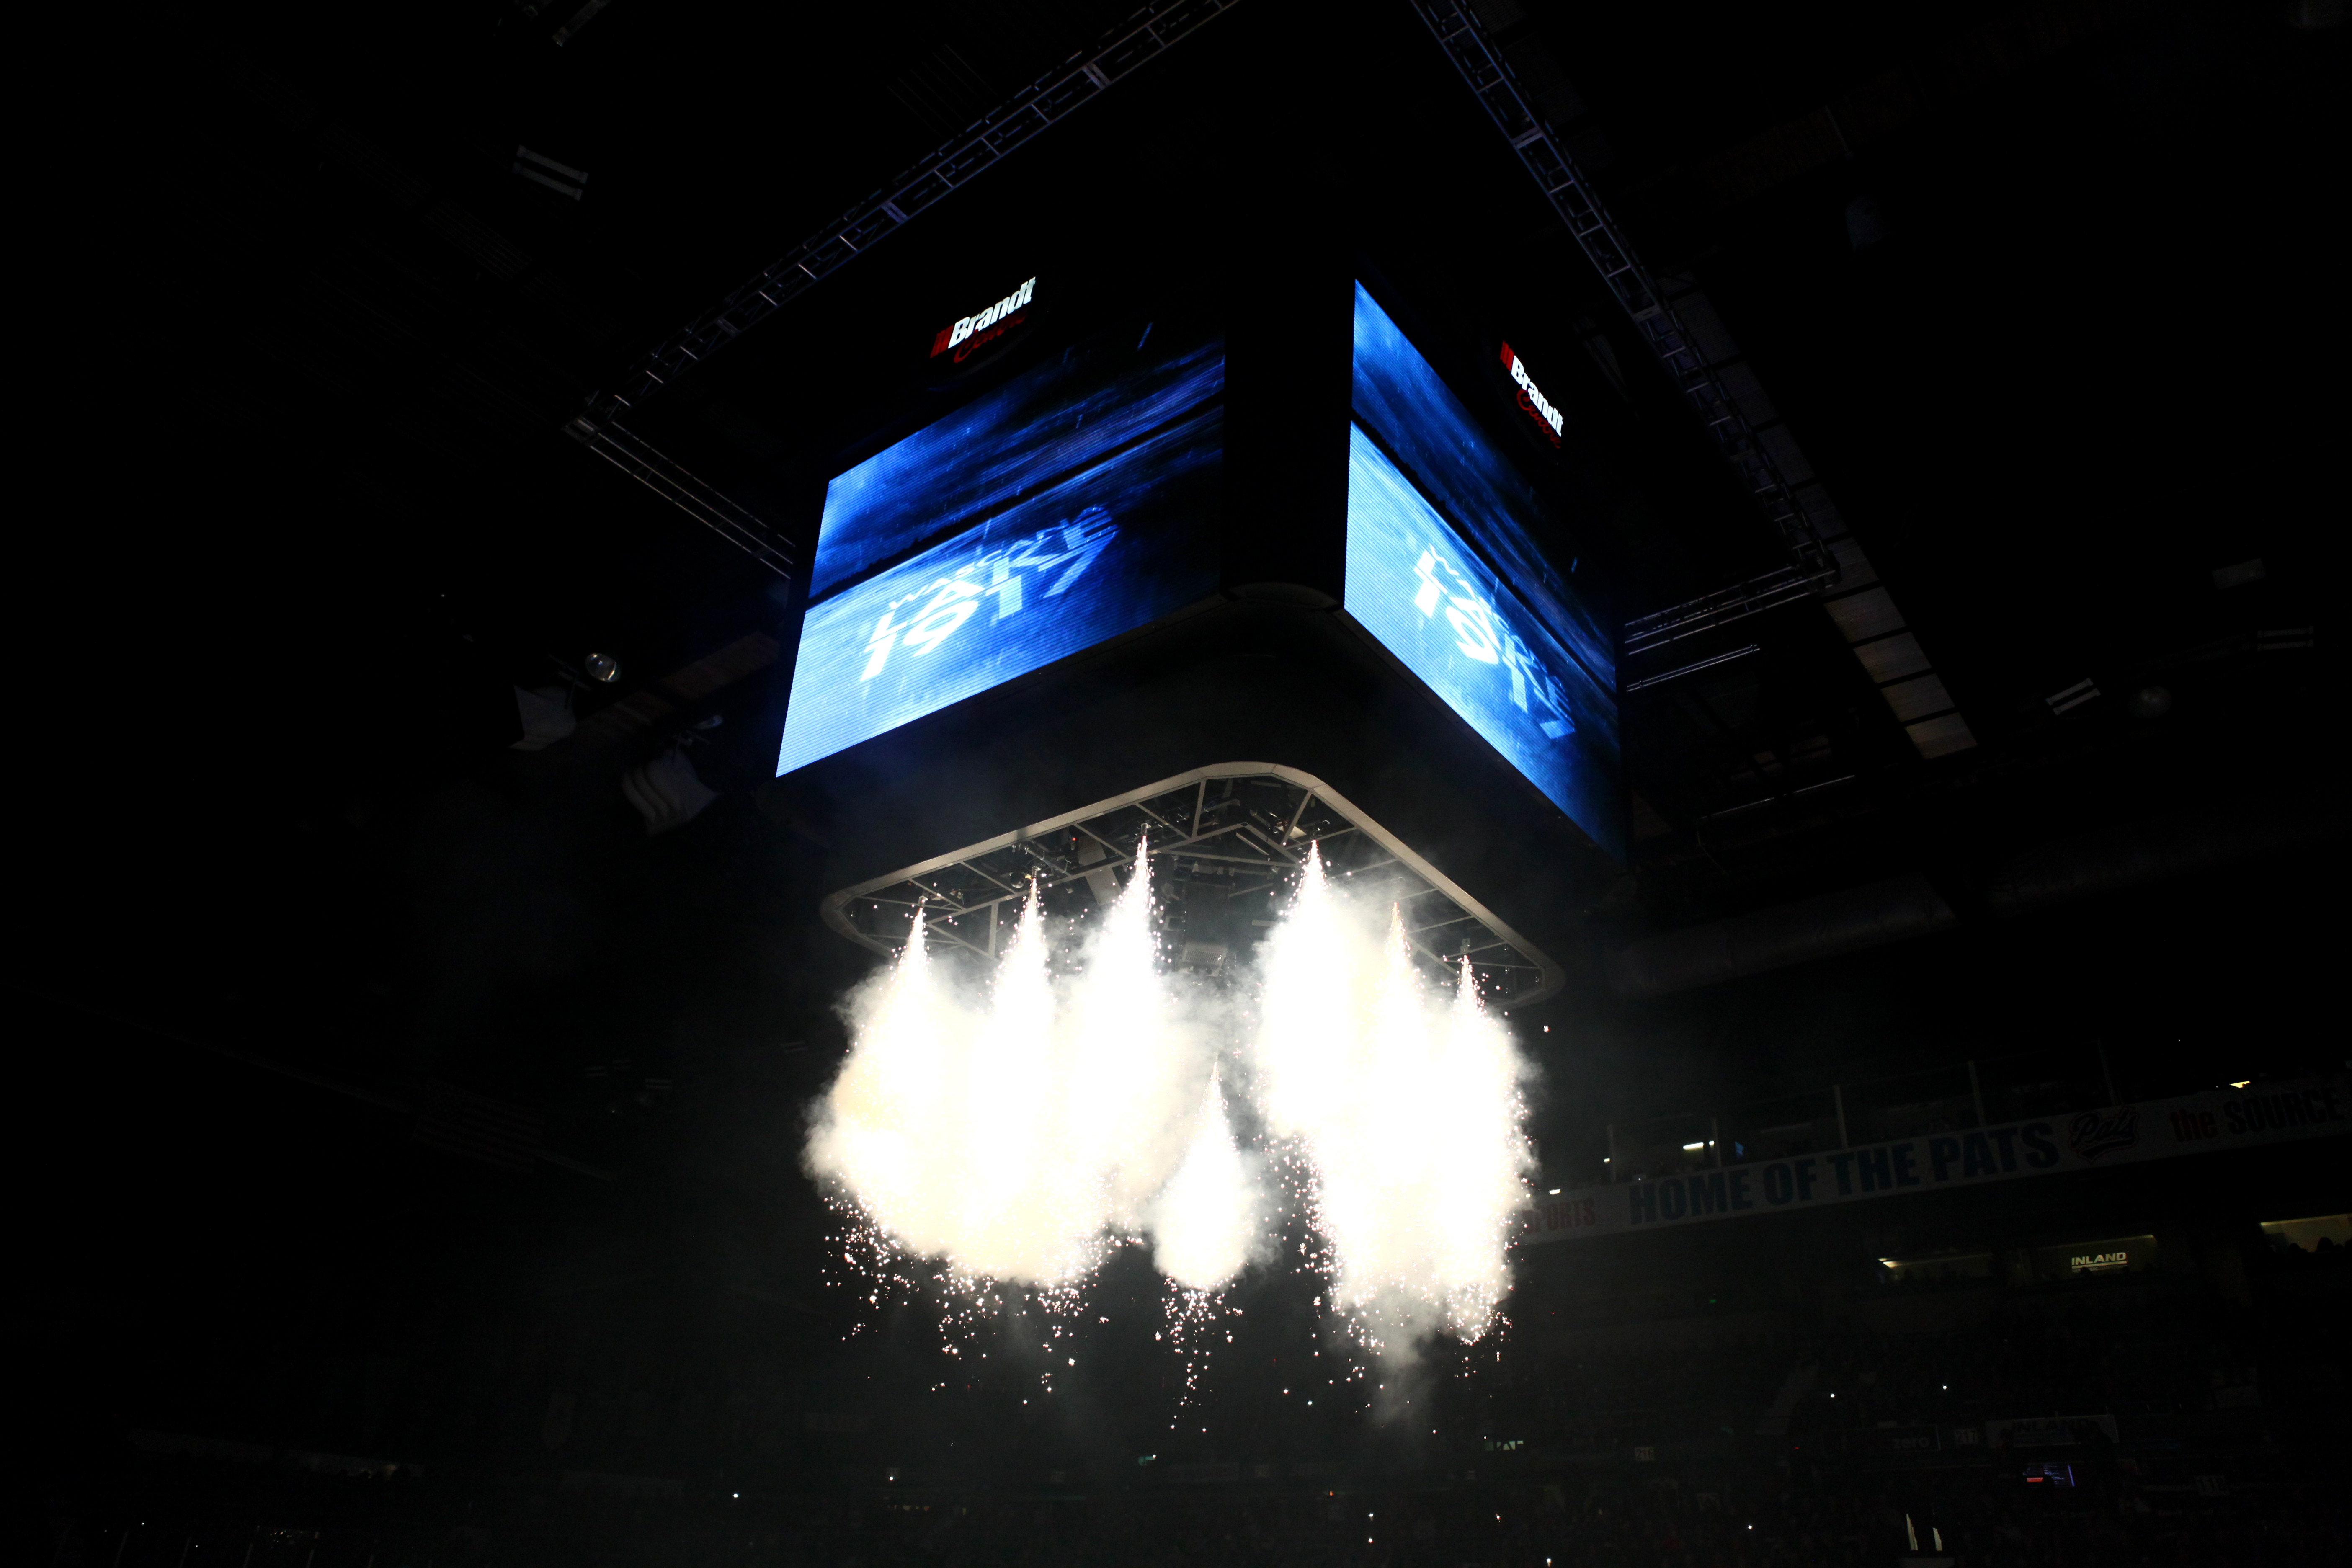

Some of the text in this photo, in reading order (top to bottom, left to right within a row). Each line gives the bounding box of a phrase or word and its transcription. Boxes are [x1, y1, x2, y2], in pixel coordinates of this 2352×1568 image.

[948, 276, 1036, 349] Brandt
[1511, 355, 1563, 437] Brandt
[2071, 1109, 2137, 1158] Pats
[2170, 1091, 2344, 1141] the SOURCE
[1629, 1122, 2059, 1225] HOME OF THE PATS
[2072, 1252, 2127, 1265] INLAND
[1637, 1449, 1653, 1459] 216
[1892, 1437, 1929, 1449] zero
